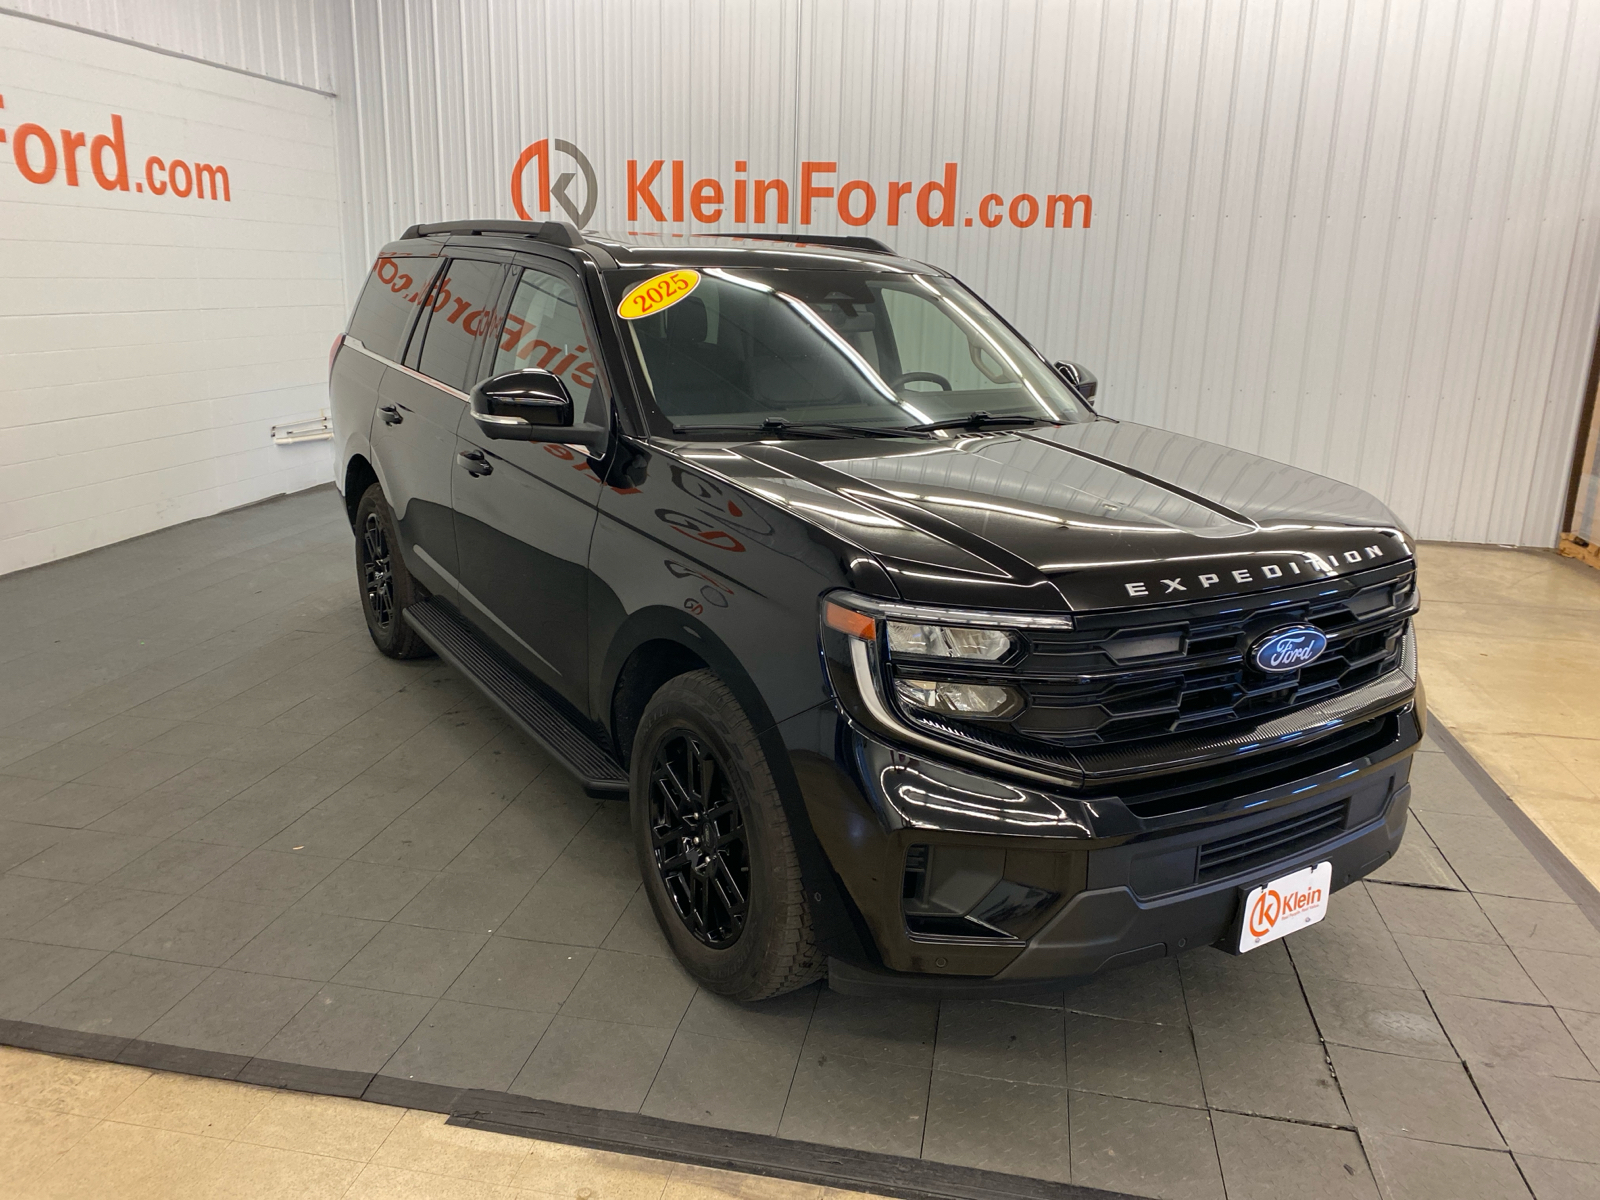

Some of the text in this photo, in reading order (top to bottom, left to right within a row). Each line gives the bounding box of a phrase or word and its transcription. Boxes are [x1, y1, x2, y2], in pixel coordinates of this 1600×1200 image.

[0, 94, 231, 202] ord.com
[626, 159, 1093, 229] KleinFord.com
[632, 273, 689, 313] 2025
[1124, 544, 1384, 597] EXPEDITION
[1270, 636, 1316, 667] Ford
[1281, 886, 1322, 915] Klein
